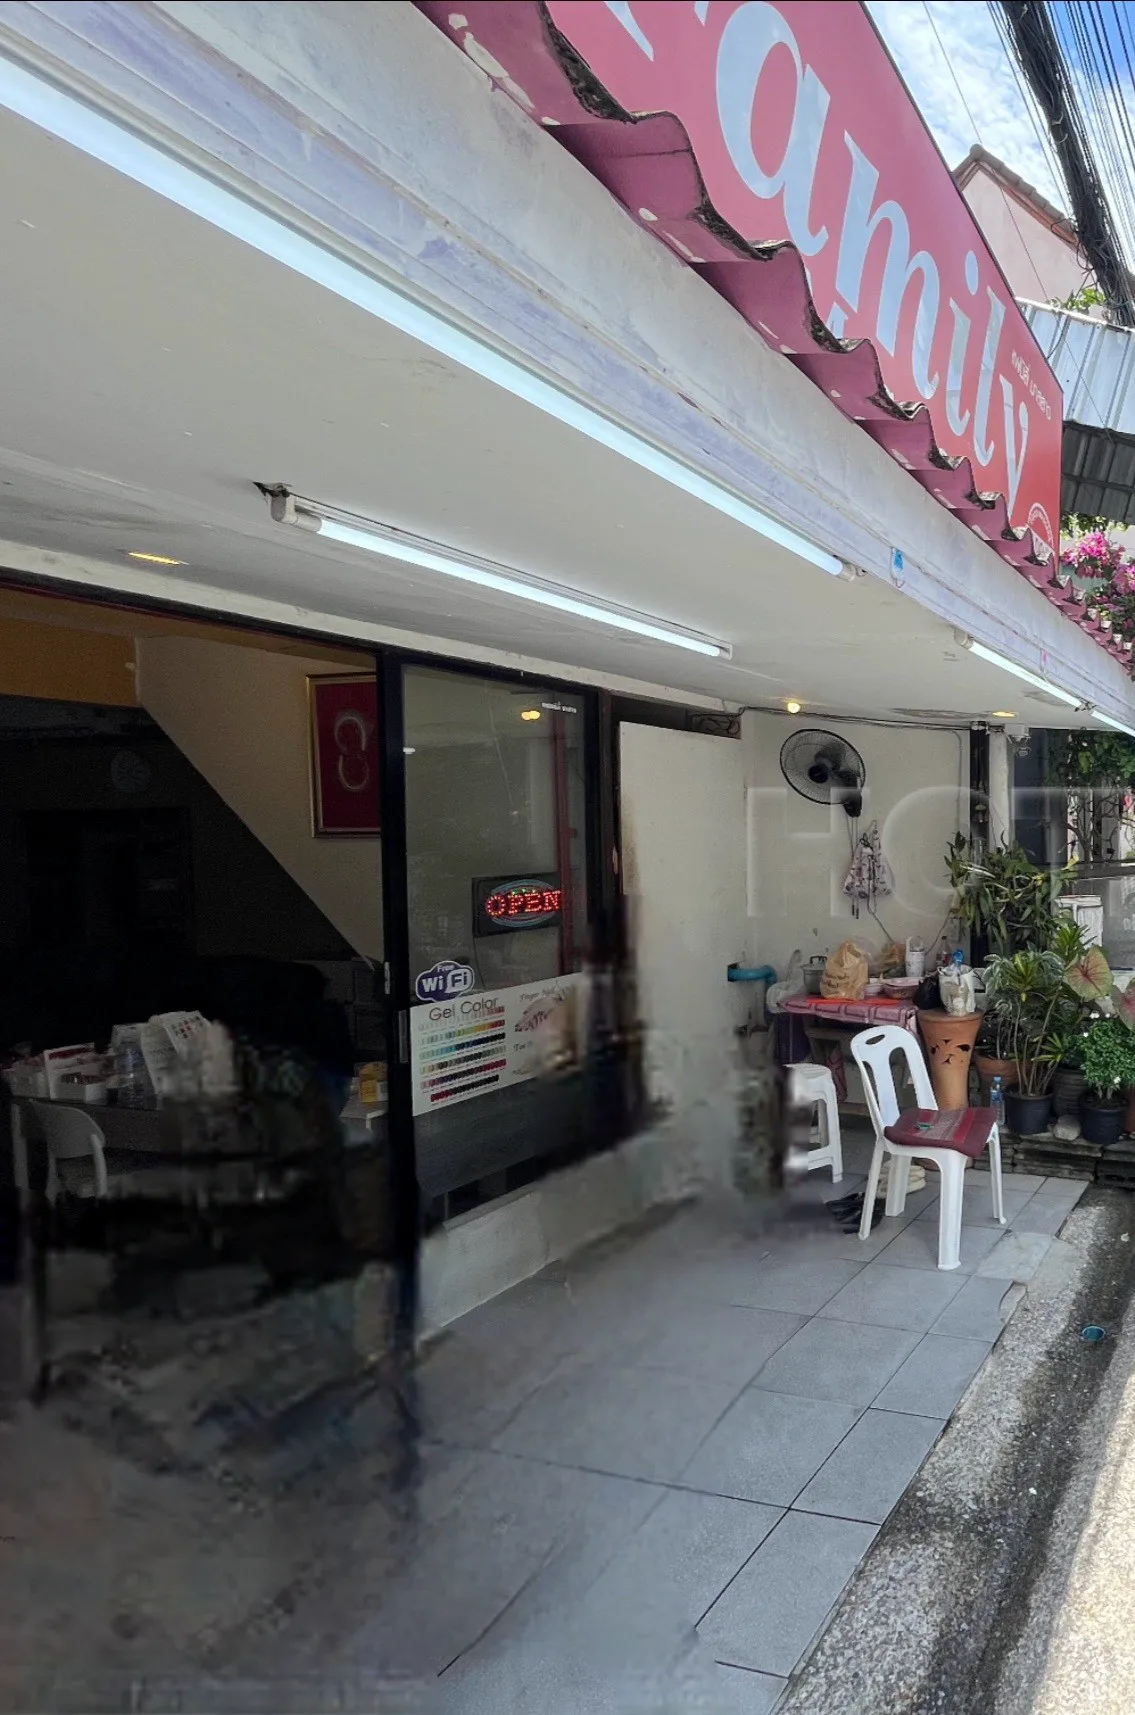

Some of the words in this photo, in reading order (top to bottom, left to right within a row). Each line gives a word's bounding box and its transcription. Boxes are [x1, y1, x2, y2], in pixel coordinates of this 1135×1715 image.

[604, 1, 1029, 522] amily
[485, 889, 563, 918] OPEN
[429, 1003, 456, 1021] Gel
[460, 997, 499, 1015] Color
